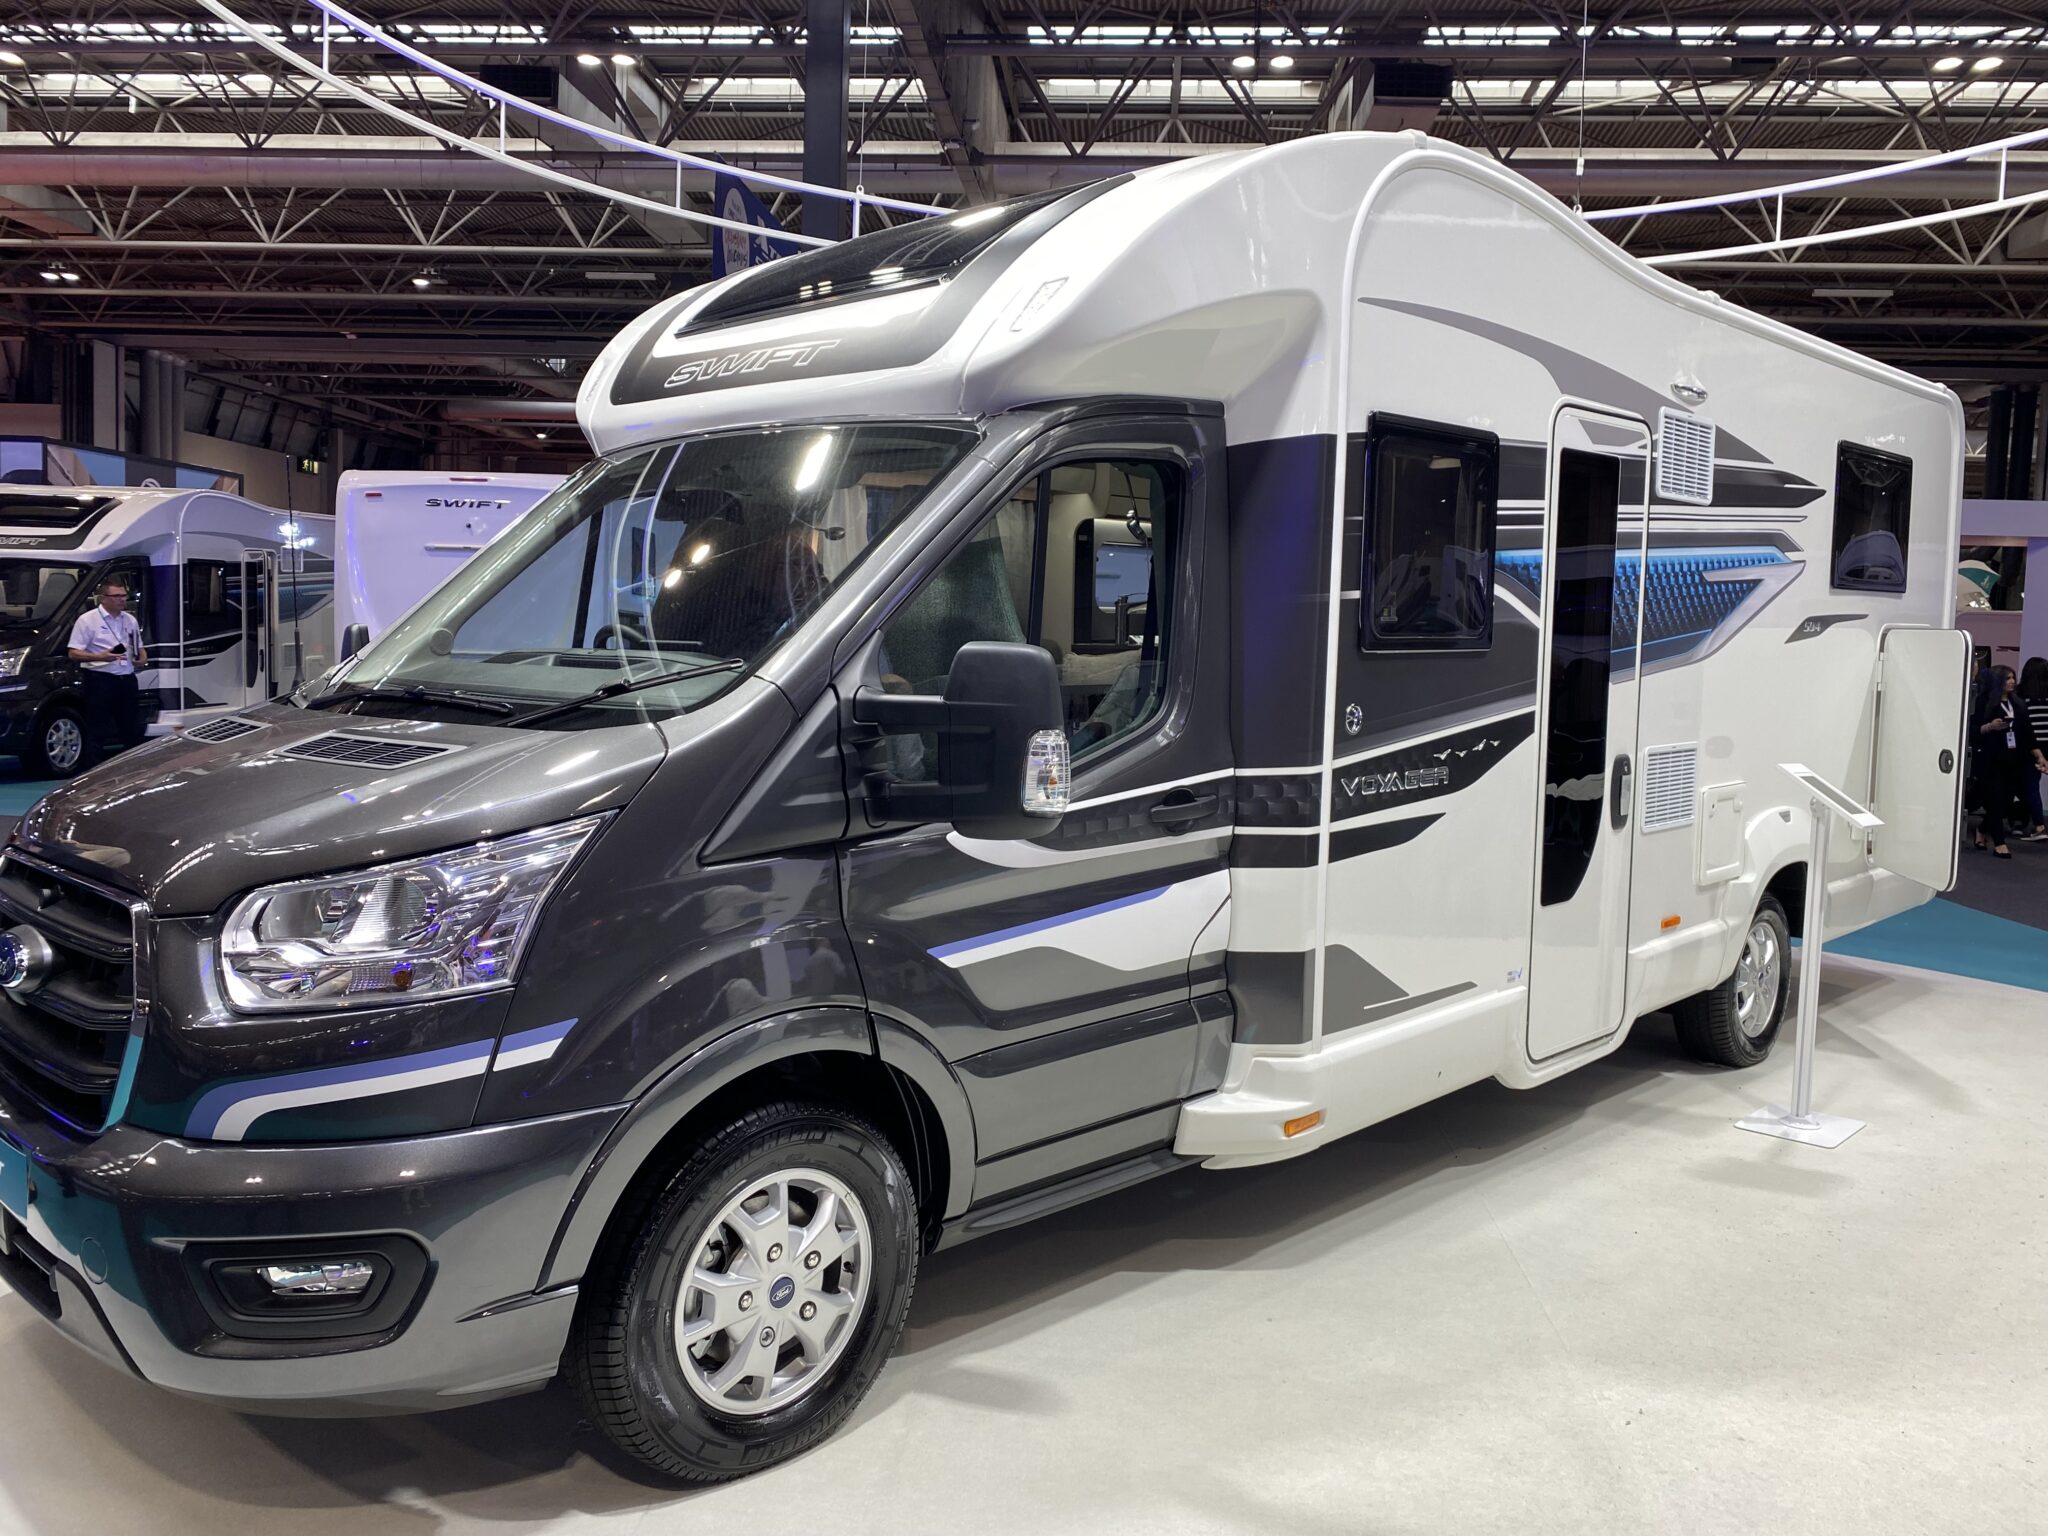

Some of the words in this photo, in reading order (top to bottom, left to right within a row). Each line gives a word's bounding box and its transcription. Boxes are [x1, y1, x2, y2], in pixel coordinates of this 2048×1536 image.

[664, 339, 842, 388] SWIFT
[425, 498, 512, 510] SWIFT
[1340, 765, 1450, 797] VOYAGER
